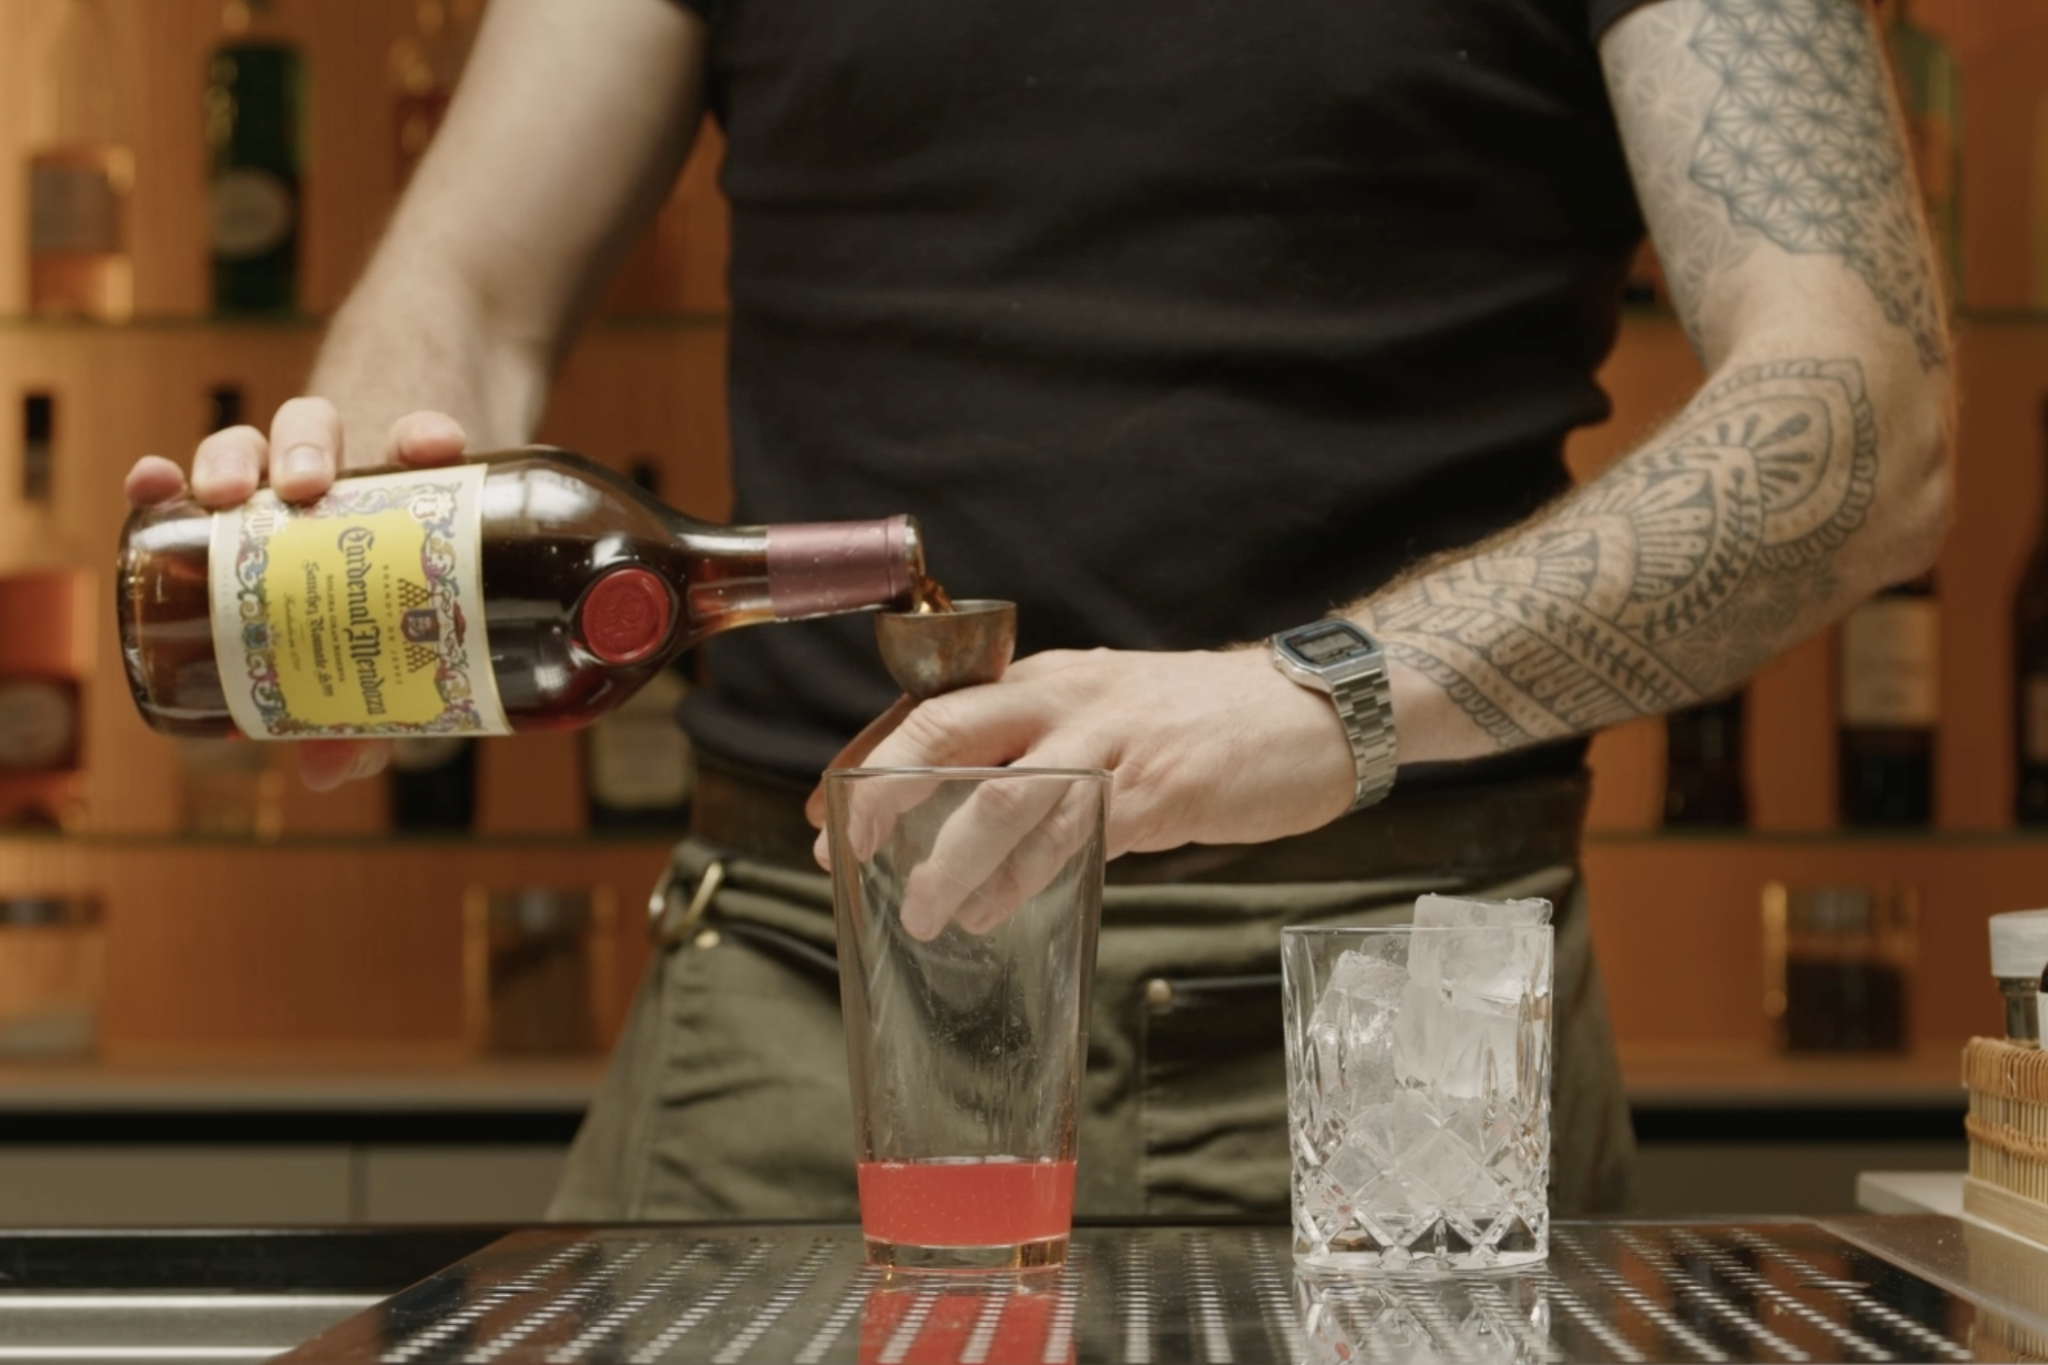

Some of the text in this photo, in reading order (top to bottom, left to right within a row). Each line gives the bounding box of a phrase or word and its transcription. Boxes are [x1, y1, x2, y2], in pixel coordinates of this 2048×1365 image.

[338, 527, 387, 716] Cardenal Mendoza
[387, 626, 395, 642] DE
